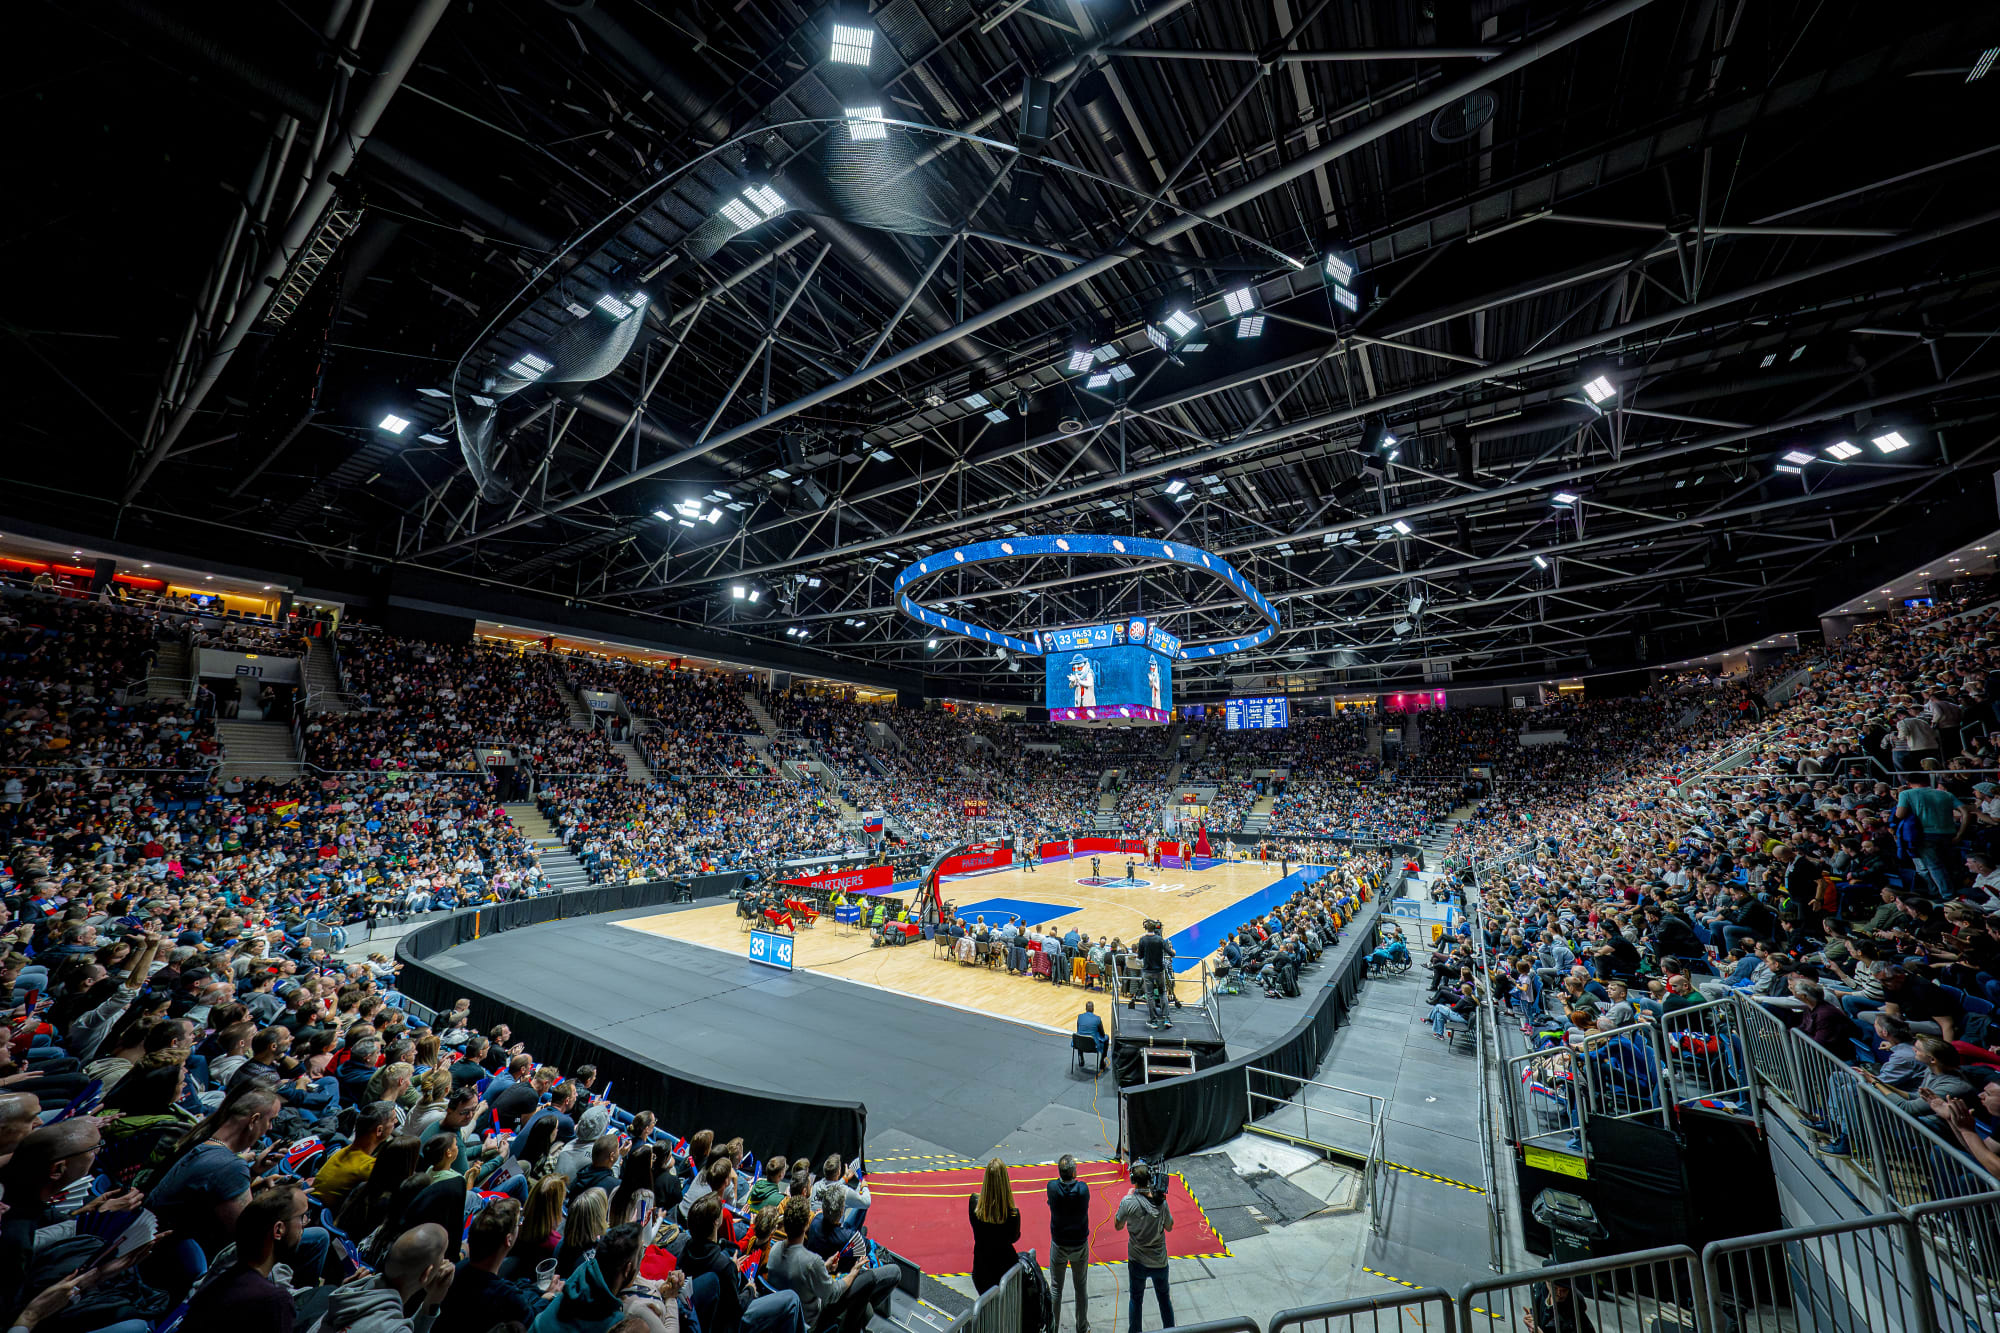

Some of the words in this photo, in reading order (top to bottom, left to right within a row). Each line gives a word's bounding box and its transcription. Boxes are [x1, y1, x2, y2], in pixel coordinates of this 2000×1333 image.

[1059, 634, 1071, 645] 33
[1072, 629, 1092, 639] 04:53
[1094, 630, 1107, 641] 43
[236, 664, 263, 678] B11
[486, 755, 506, 766] A11
[961, 855, 994, 868] PARTNERS
[751, 937, 765, 957] 33
[776, 943, 792, 963] 43
